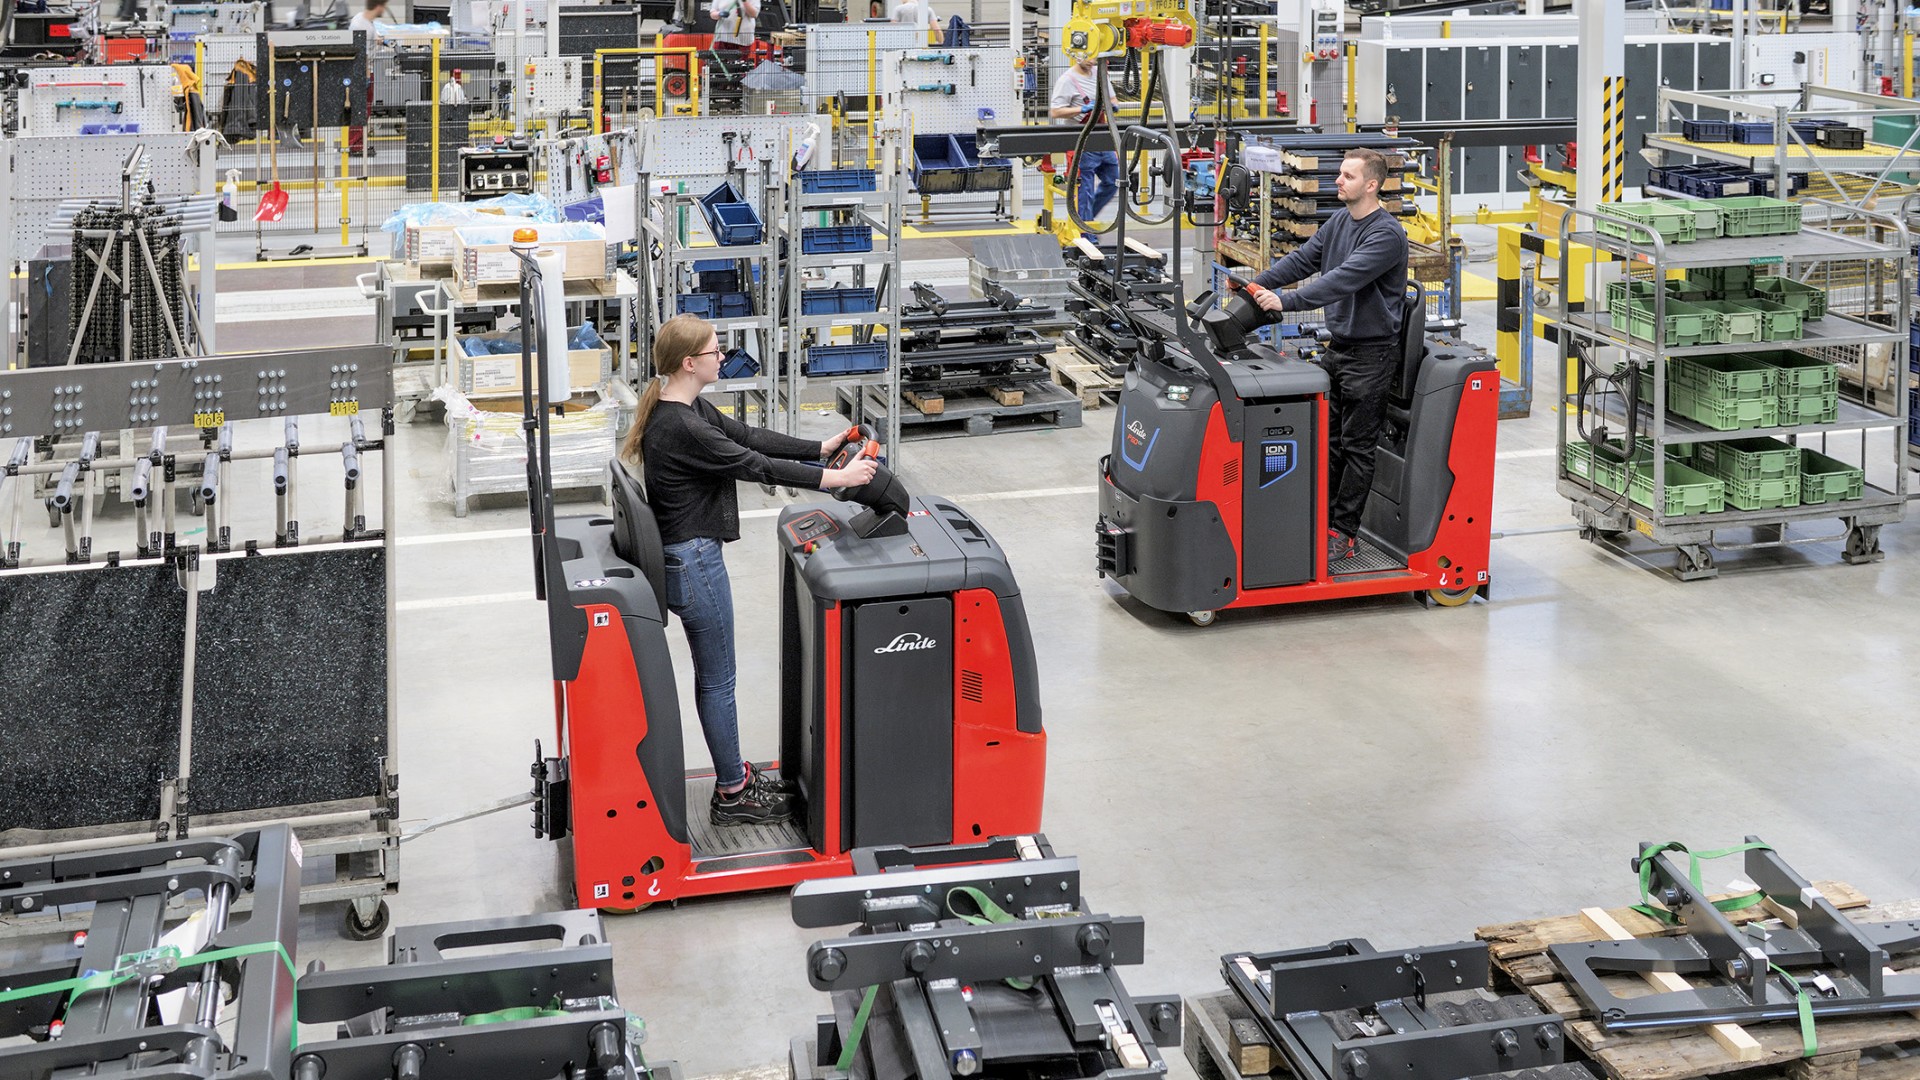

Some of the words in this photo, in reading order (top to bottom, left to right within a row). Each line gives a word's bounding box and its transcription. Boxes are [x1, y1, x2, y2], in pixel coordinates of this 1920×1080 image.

[333, 405, 357, 415] 113
[196, 416, 223, 426] 103
[1127, 420, 1147, 440] Linde
[1265, 445, 1287, 454] ION
[873, 632, 937, 654] Linde
